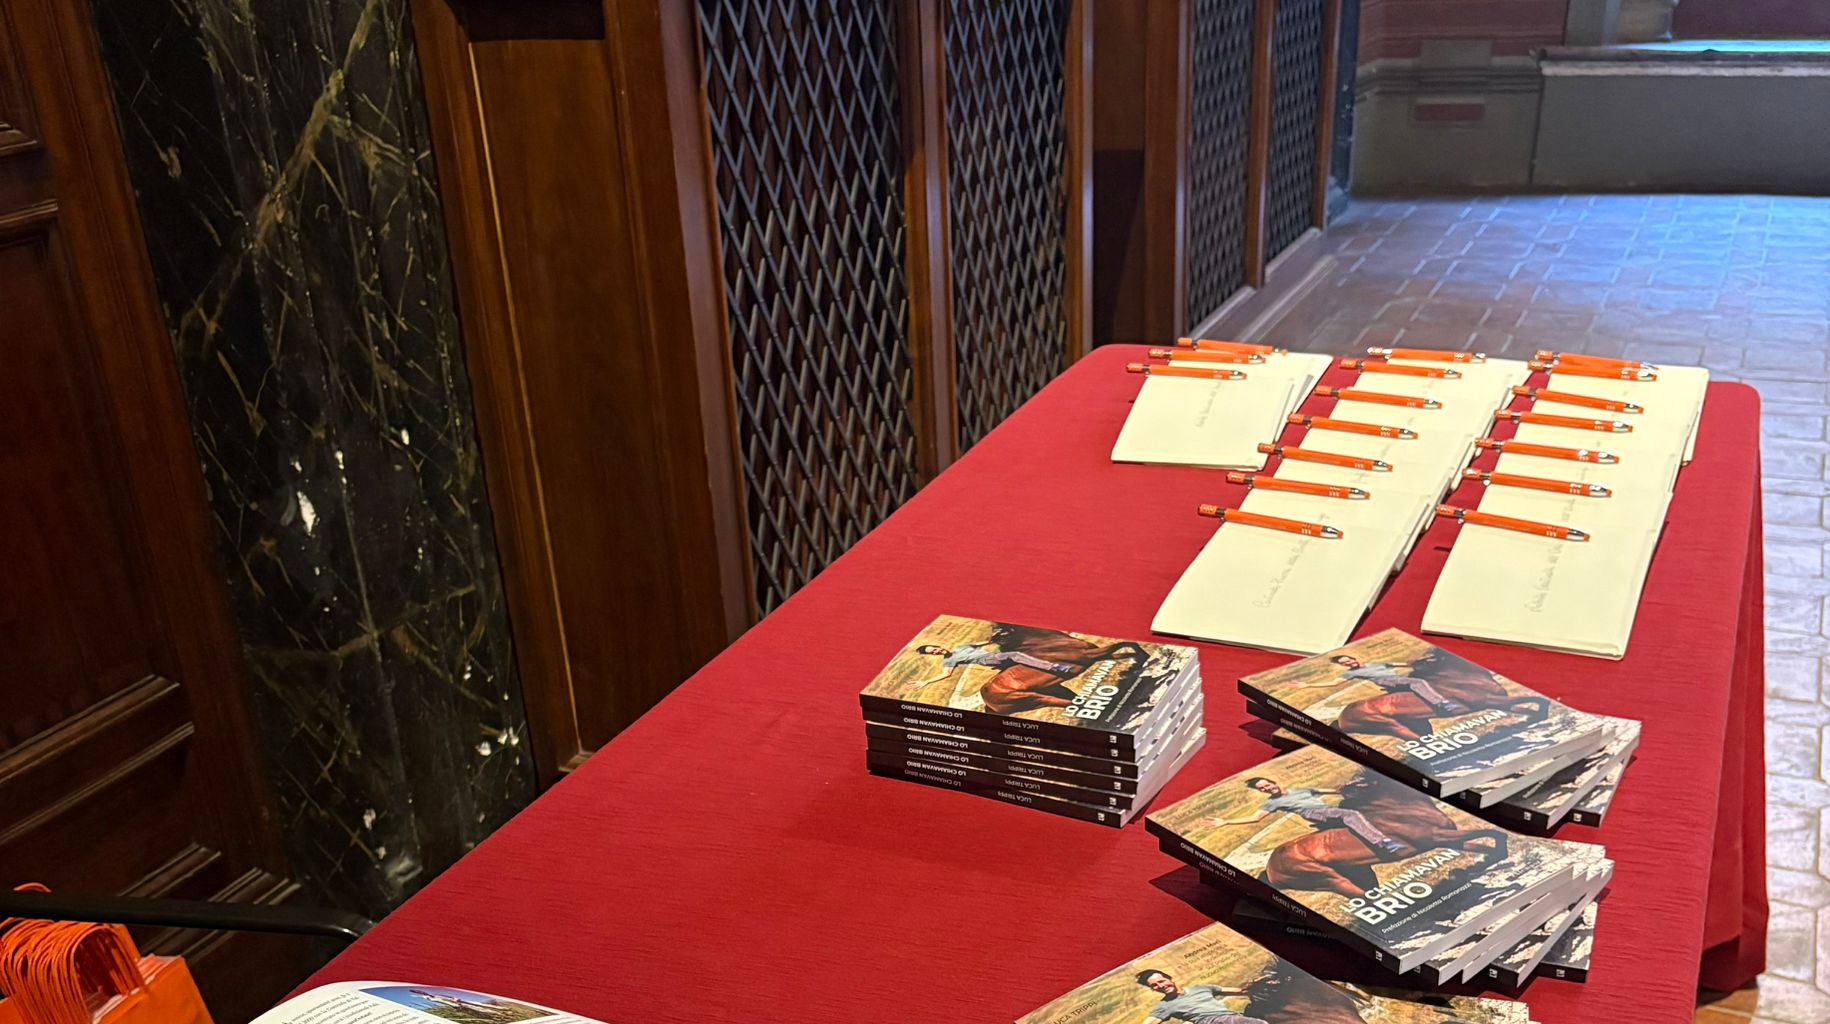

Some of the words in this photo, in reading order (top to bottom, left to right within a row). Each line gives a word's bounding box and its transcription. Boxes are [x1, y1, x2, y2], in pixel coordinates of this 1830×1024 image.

[1061, 705, 1079, 718] LO
[1072, 660, 1116, 705] CHIAMAVAN
[1076, 685, 1119, 720] BRIO
[1396, 740, 1420, 752] LO
[1420, 710, 1507, 743] CHIAMAVAN
[1408, 732, 1478, 760] BRIO
[1339, 898, 1365, 913] LO
[1365, 849, 1460, 900] CHIAMAVAN
[1354, 882, 1432, 925] BRIO
